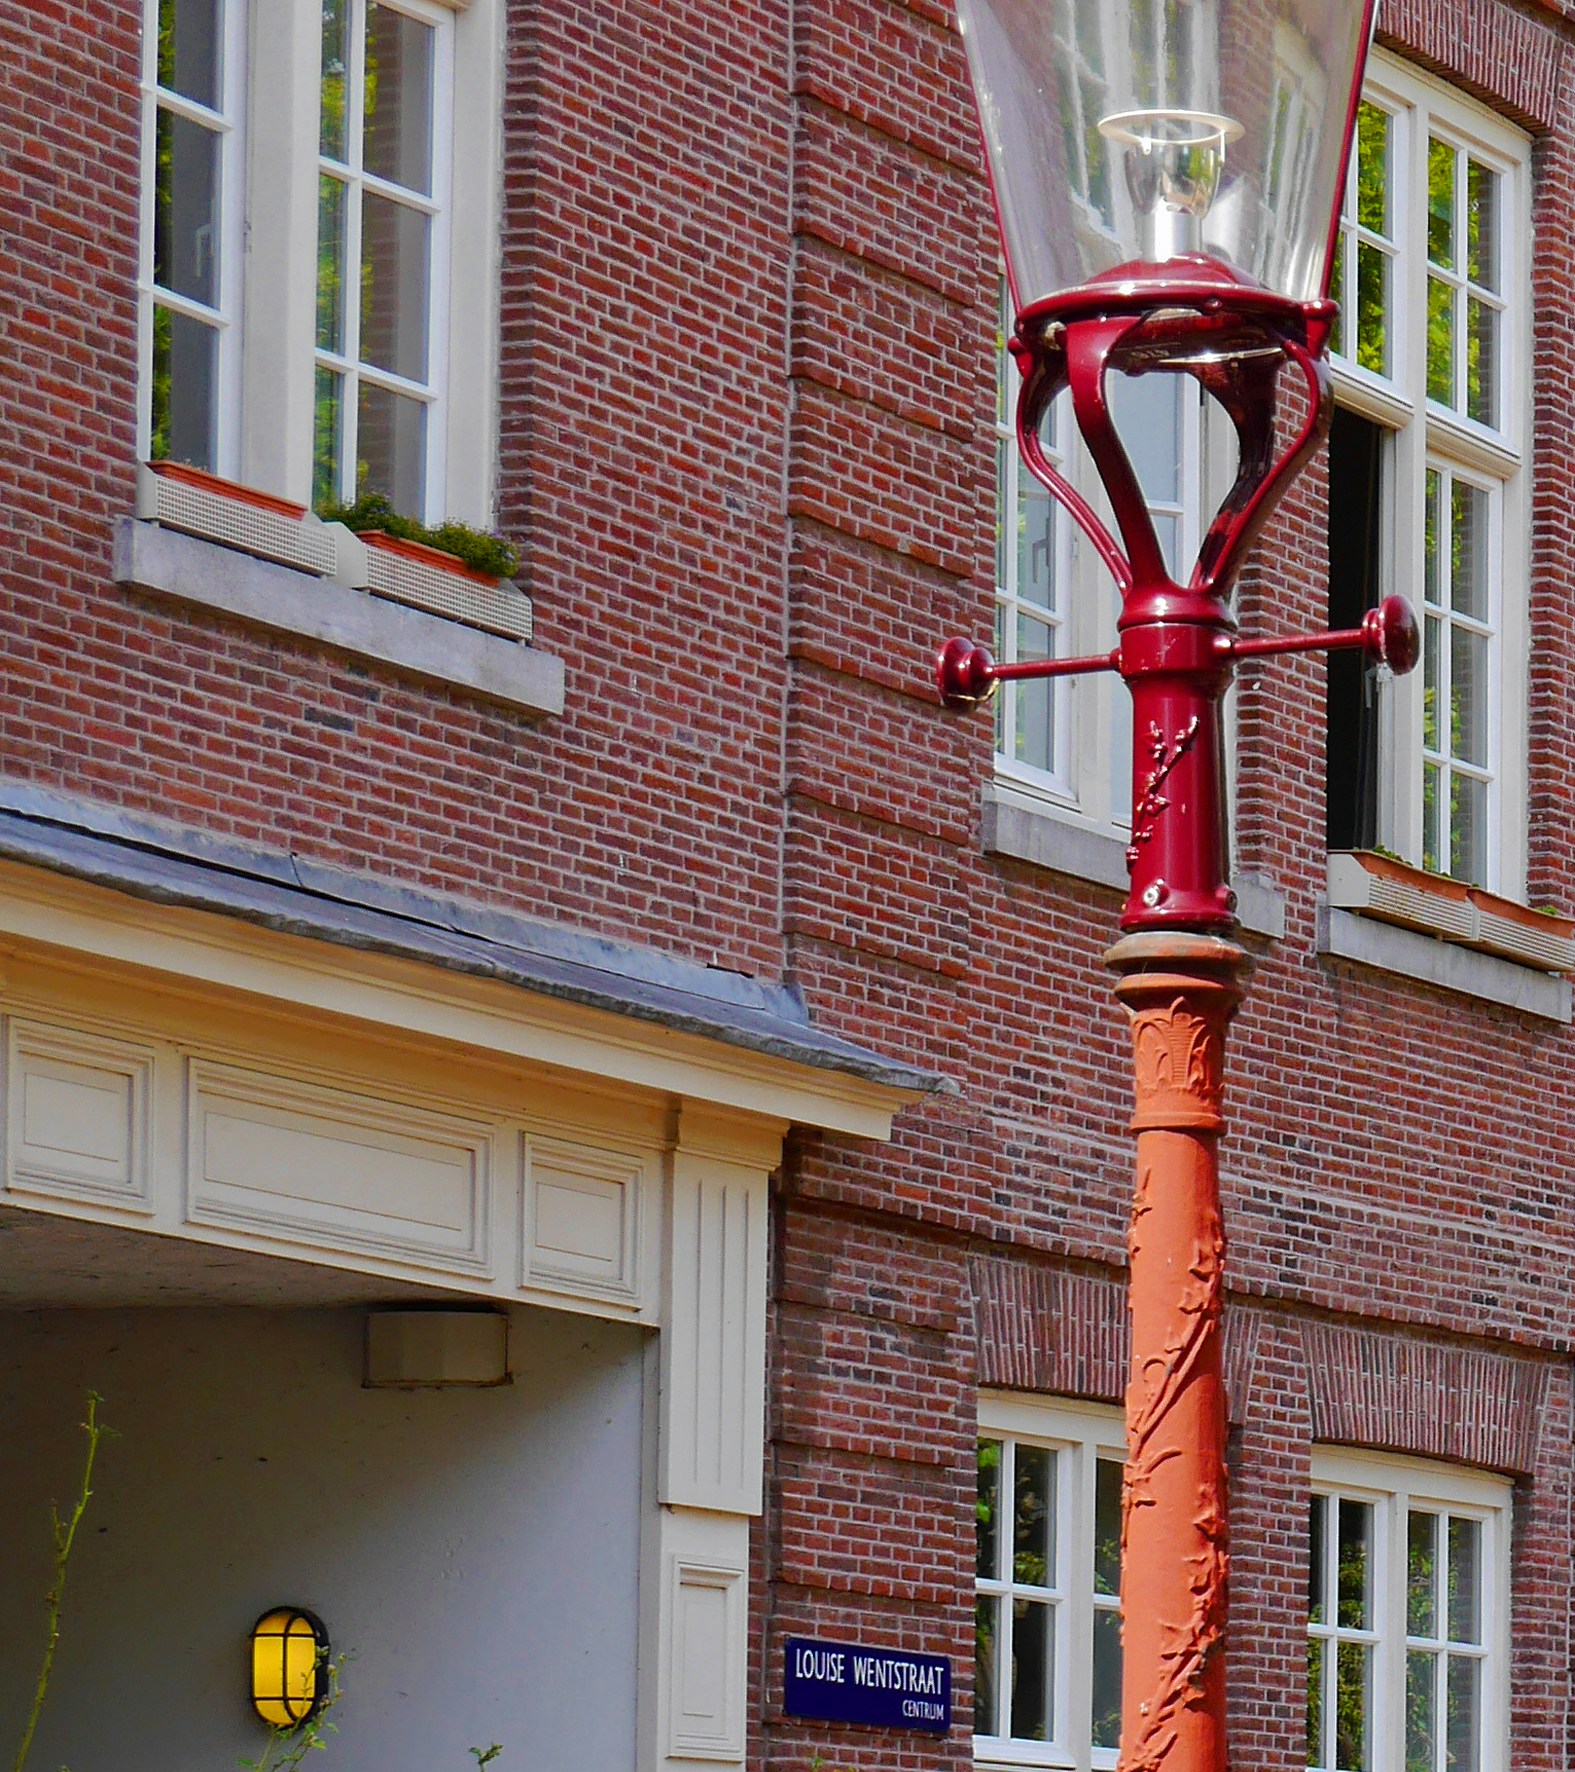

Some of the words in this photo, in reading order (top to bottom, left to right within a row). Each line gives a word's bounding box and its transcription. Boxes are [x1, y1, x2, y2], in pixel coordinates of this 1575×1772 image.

[795, 1648, 845, 1683] LOUISE
[853, 1656, 944, 1695] WENTSTRAAT
[902, 1700, 944, 1720] CENTRUM
